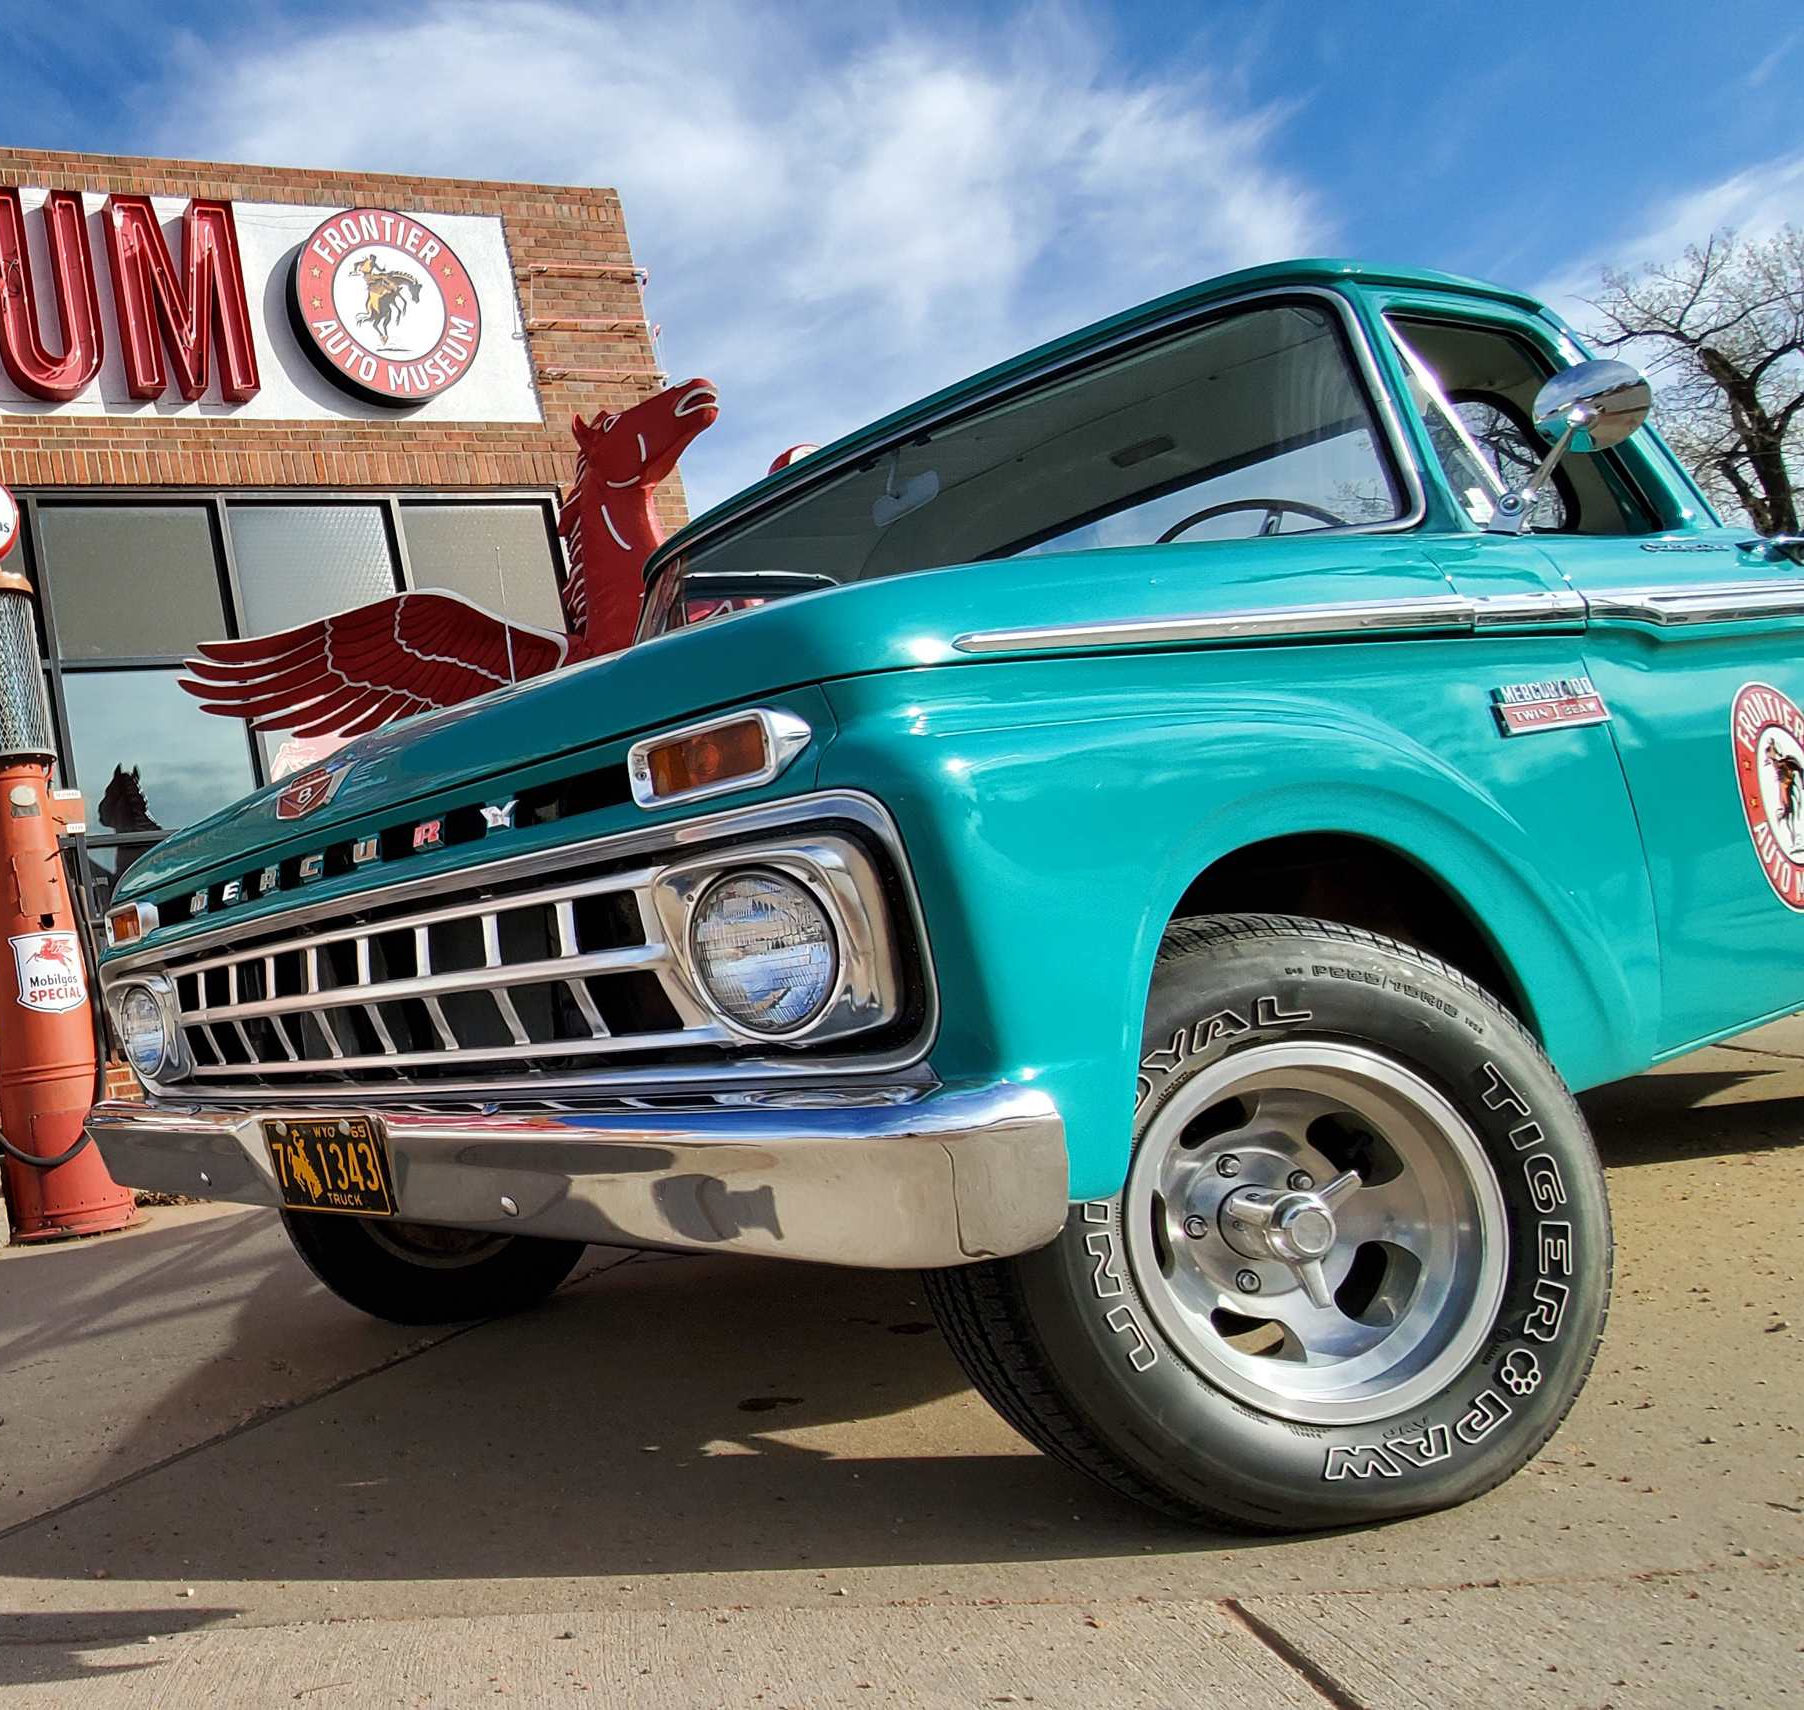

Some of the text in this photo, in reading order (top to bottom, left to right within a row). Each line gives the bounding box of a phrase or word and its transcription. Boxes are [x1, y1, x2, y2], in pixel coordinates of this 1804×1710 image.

[312, 213, 441, 266] FRONTIER
[312, 315, 475, 394] AUTO MUSEUM
[1499, 680, 1563, 704] MERCURY
[1512, 708, 1549, 722] TWIN
[1737, 692, 1804, 753] FRONTIER
[190, 799, 519, 916] MERCURY
[1754, 821, 1792, 894] AUTO
[29, 973, 78, 988] Mobilgas
[29, 986, 82, 1003] SPECIAL
[312, 1125, 367, 1139] WYO 65
[272, 1142, 380, 1192] 7 1343
[326, 1192, 364, 1207] TRUCK
[1481, 1060, 1573, 1342] TIGER
[1324, 1389, 1513, 1481] PAW
